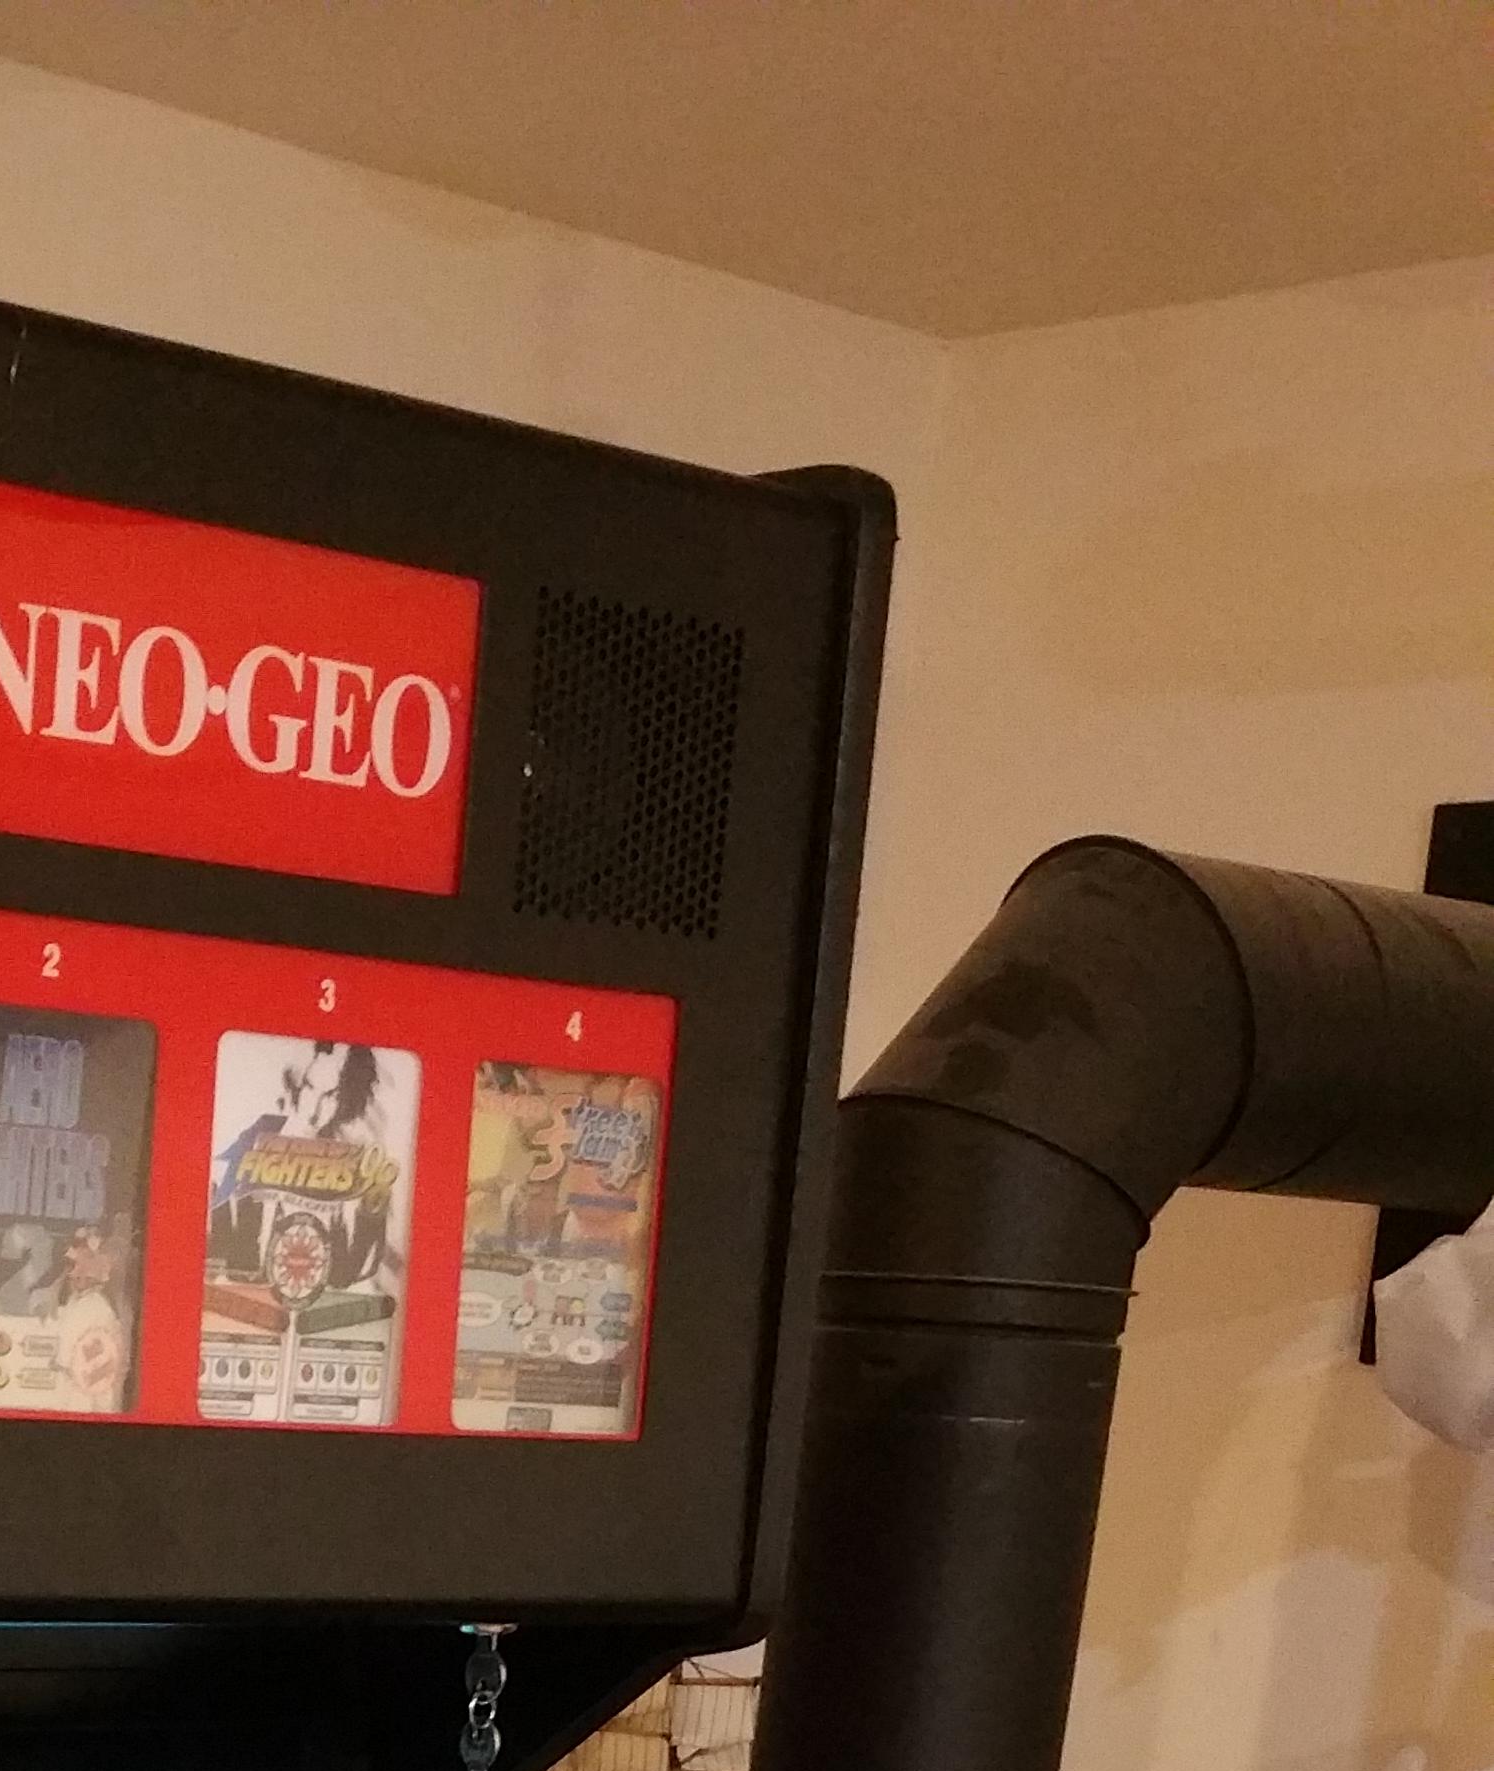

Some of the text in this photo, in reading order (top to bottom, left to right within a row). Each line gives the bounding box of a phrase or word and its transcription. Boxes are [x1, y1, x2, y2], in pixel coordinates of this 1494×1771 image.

[40, 942, 62, 979] 2
[318, 978, 337, 1014] 3
[565, 1010, 584, 1042] 4
[235, 1150, 355, 1192] FIGHTERS
